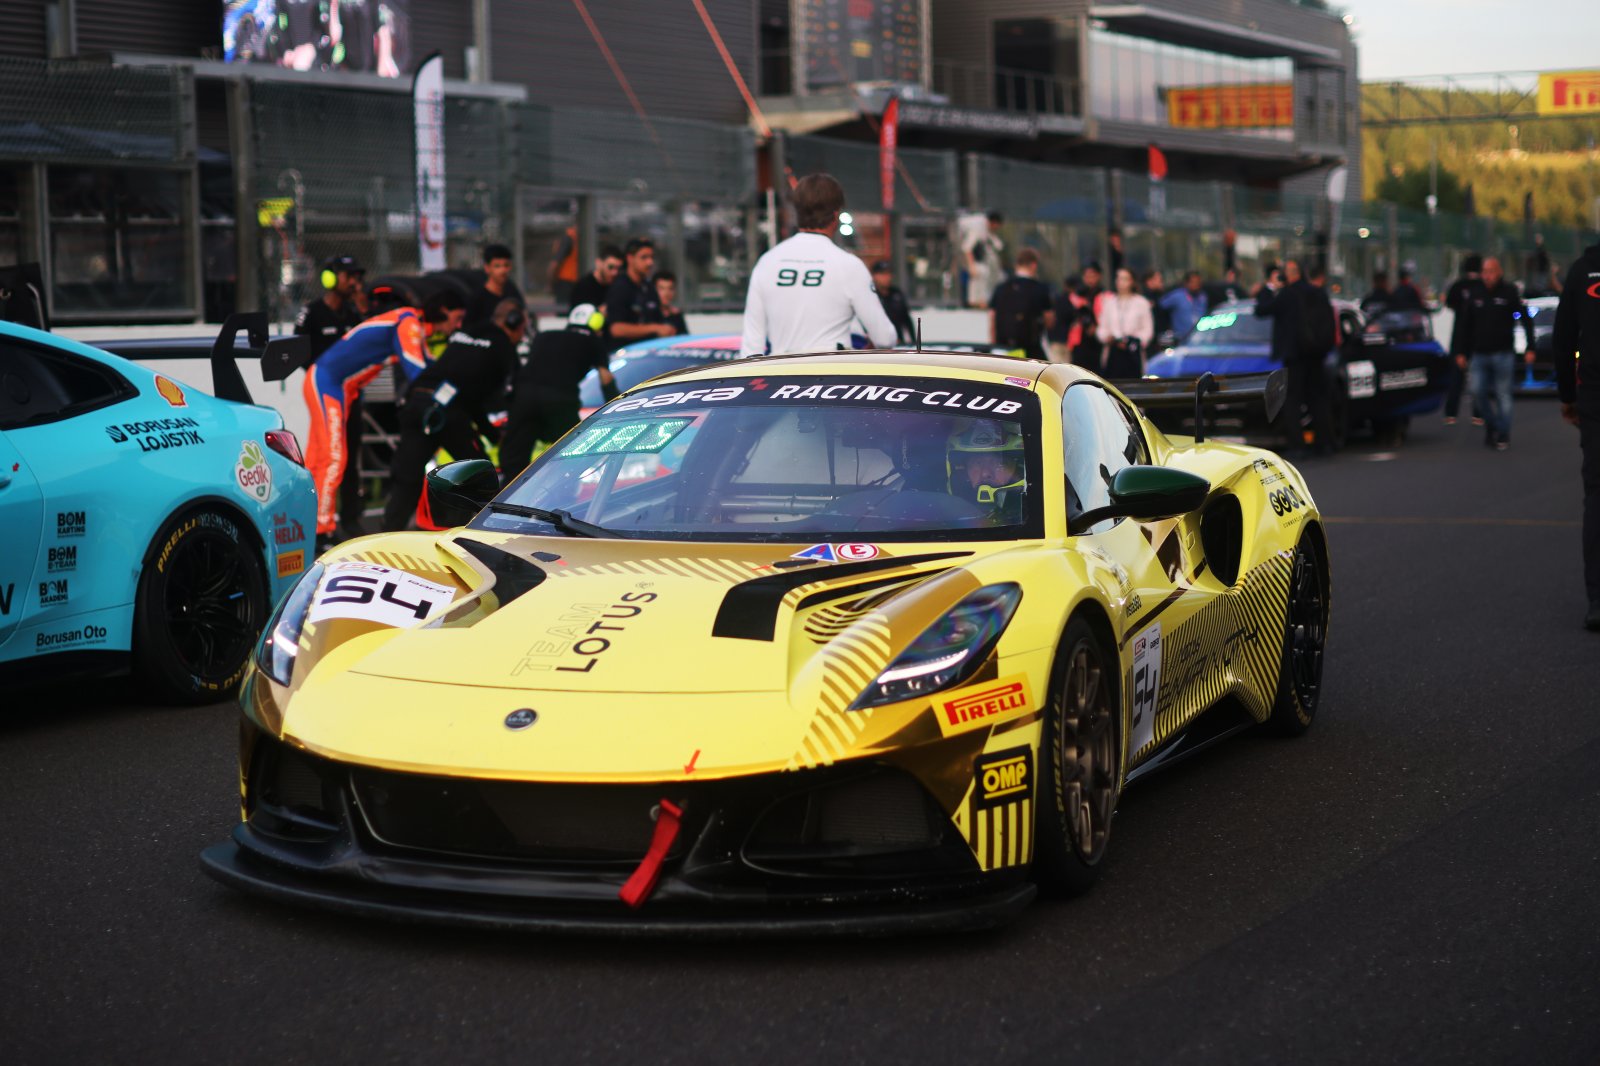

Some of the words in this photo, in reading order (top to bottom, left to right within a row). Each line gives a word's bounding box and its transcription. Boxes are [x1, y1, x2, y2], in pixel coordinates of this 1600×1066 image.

[776, 269, 825, 287] 98
[769, 384, 916, 402] RACING
[921, 391, 1023, 414] CLUB
[122, 417, 200, 435] BORUSAN
[238, 465, 269, 487] Gedik
[57, 511, 86, 526] BOM
[57, 525, 86, 535] KARTING
[274, 519, 306, 545] HELIX
[48, 545, 77, 562] BOM
[157, 518, 197, 573] PIRELLI
[320, 575, 433, 620] 54
[36, 630, 82, 647] Borusan
[83, 625, 107, 639] Oto
[510, 603, 608, 676] TEAM
[555, 592, 658, 673] LOTUS
[943, 682, 1026, 726] PIRELLI
[1133, 664, 1157, 729] 54
[983, 762, 1027, 793] OMP
